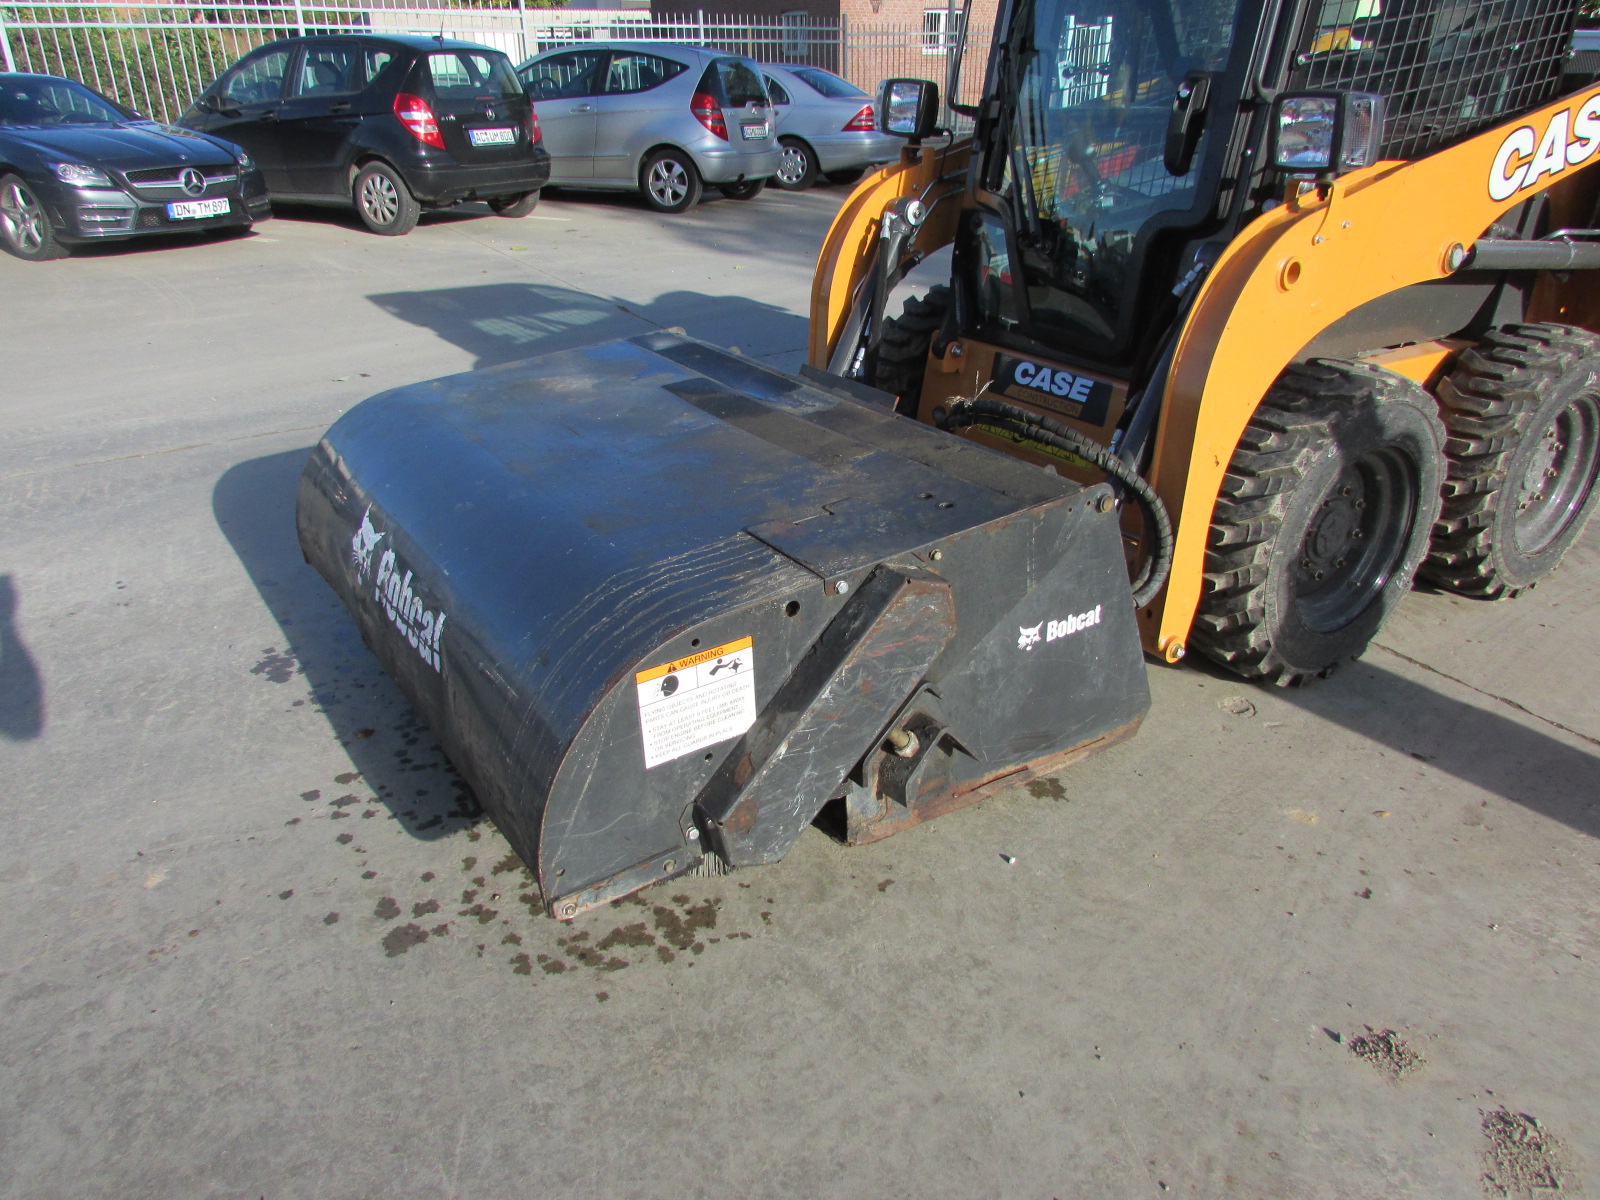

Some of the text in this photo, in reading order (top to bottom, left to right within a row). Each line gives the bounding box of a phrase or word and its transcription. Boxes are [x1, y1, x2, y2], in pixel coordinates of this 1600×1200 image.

[175, 200, 228, 216] DN TM 897
[1014, 361, 1095, 403] CASE
[1017, 388, 1080, 416] CONSTRUCTION
[1046, 604, 1102, 643] Bobcat
[679, 647, 724, 668] WARNING
